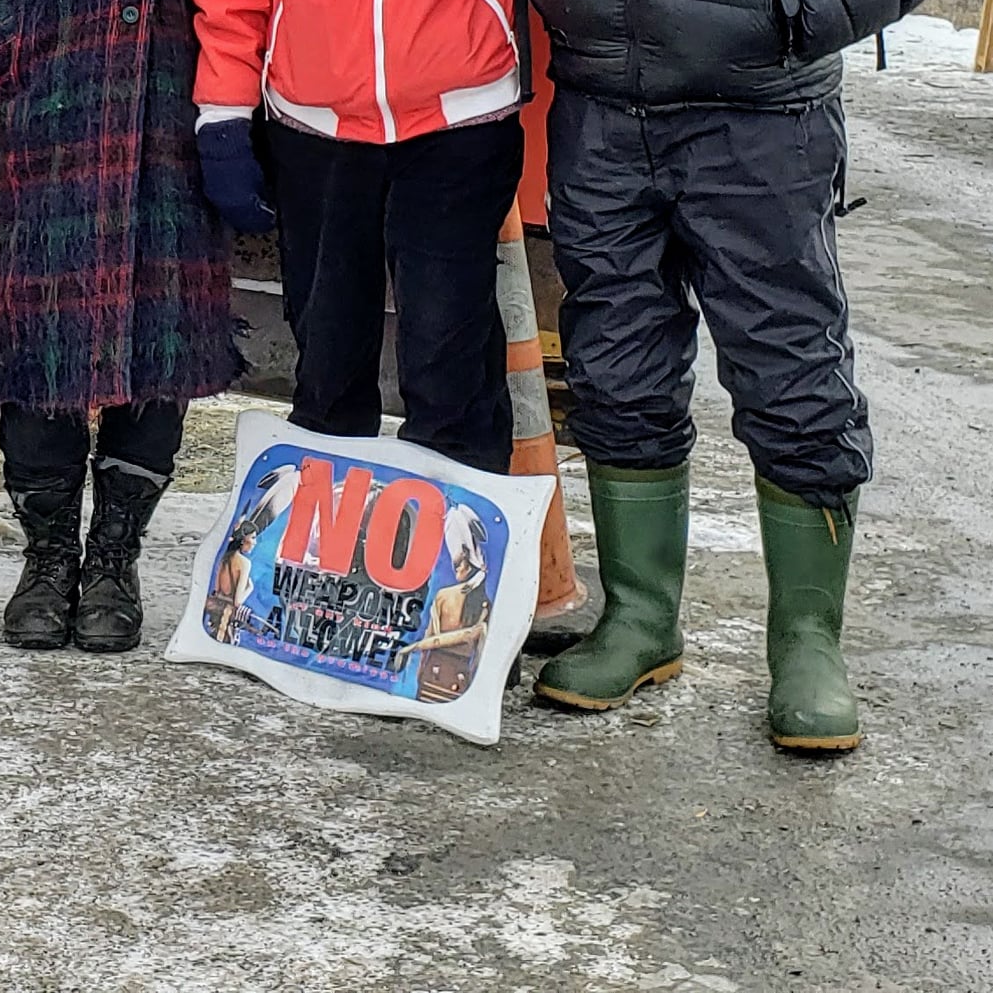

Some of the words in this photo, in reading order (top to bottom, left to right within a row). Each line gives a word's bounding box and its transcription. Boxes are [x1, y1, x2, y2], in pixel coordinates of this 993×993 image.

[279, 457, 447, 592] NO
[273, 566, 425, 632] WEAPONS
[259, 606, 410, 673] ALLOWED
